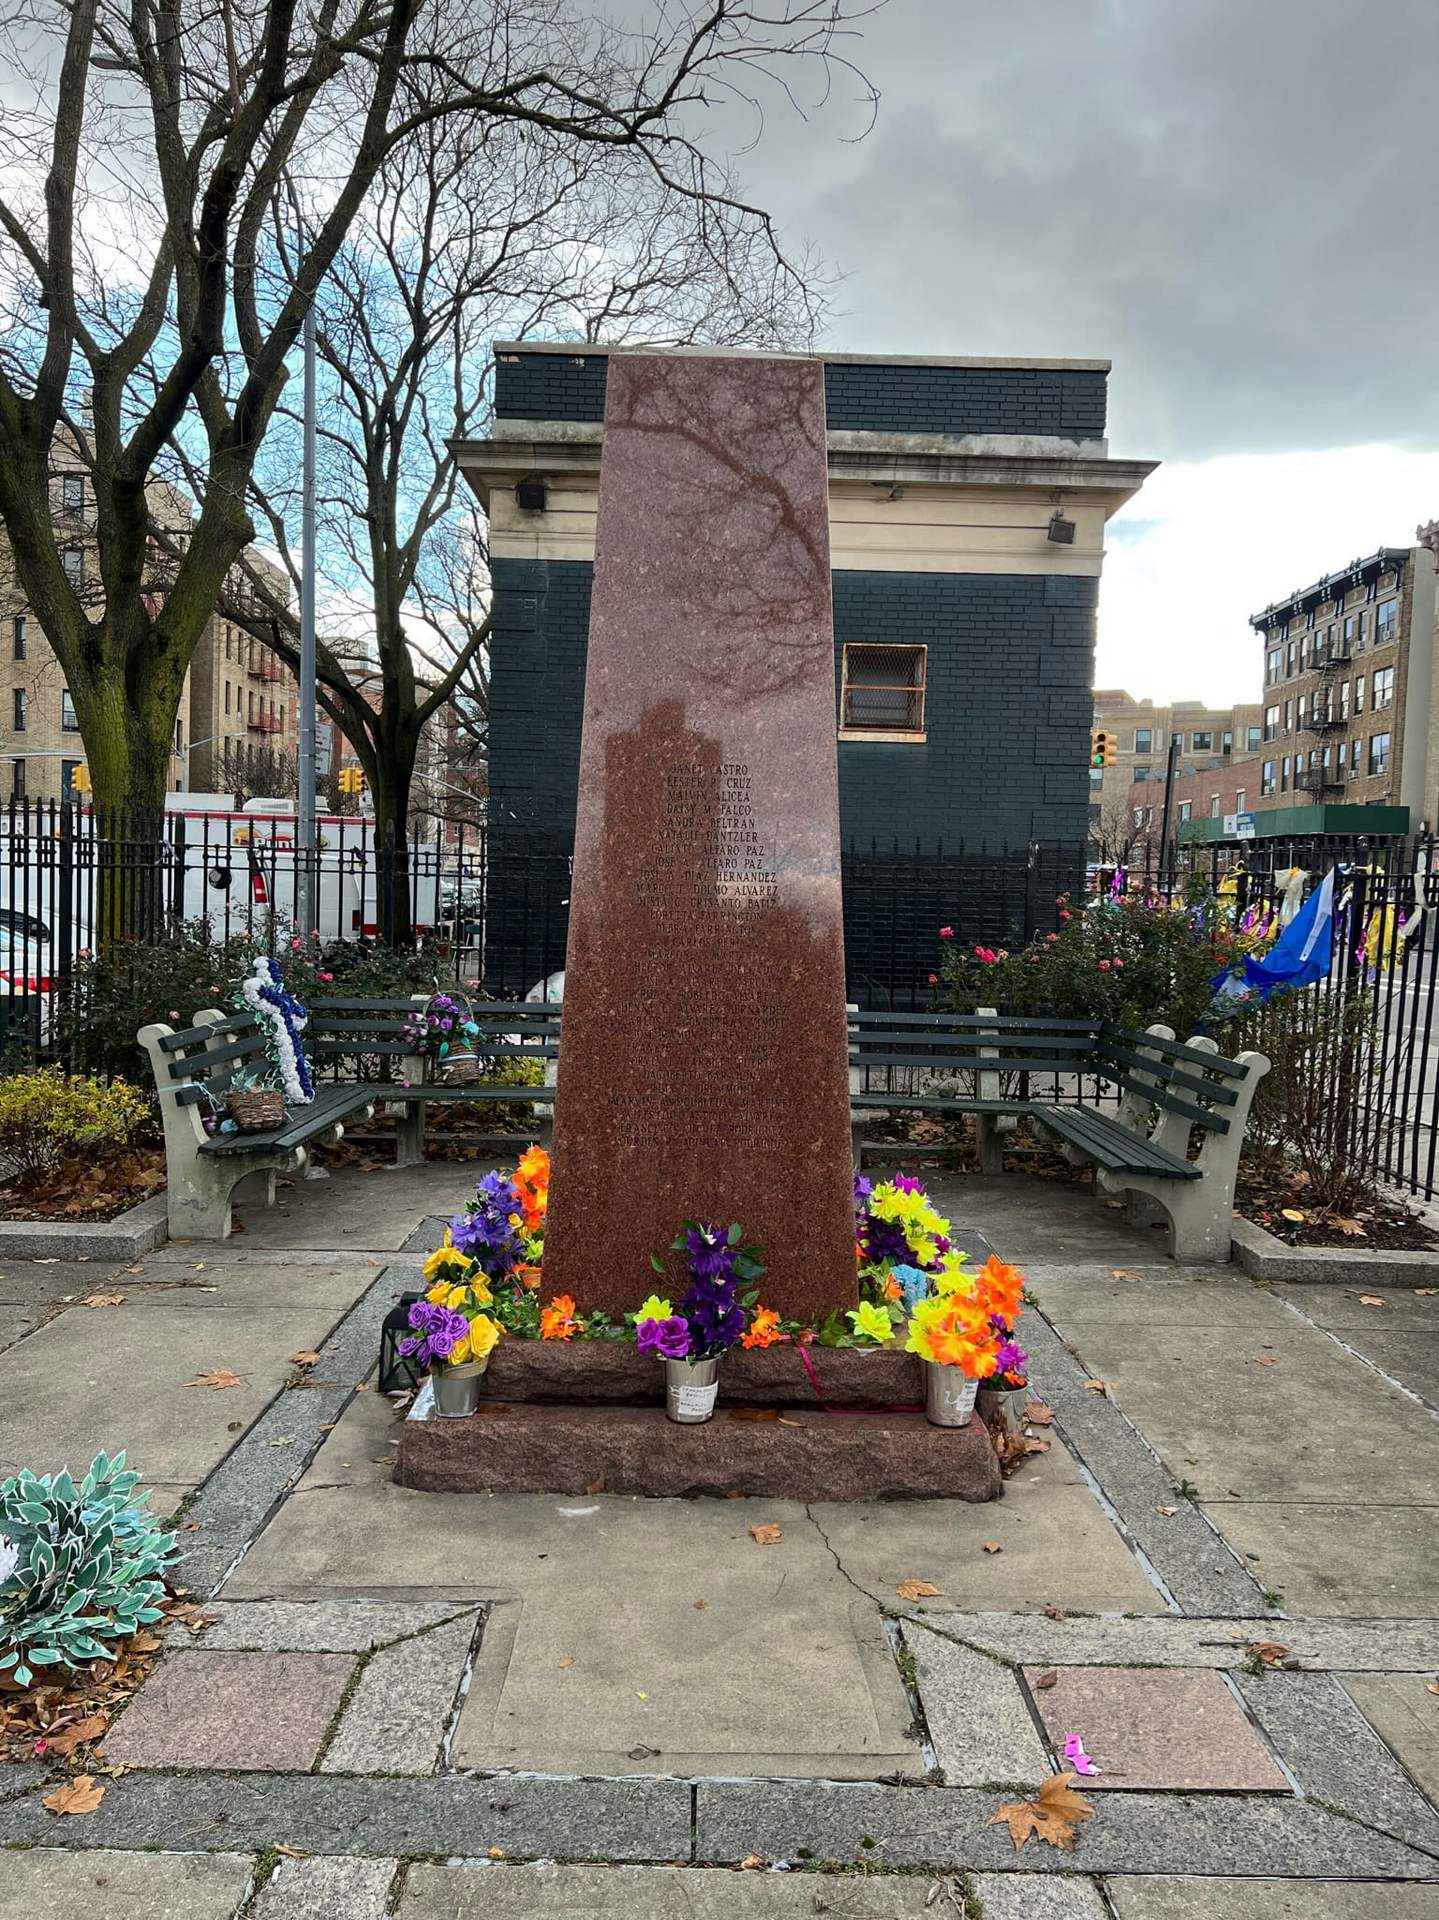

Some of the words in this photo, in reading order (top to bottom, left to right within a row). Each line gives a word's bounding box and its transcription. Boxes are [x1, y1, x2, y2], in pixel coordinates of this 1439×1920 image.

[711, 764, 749, 775] CASTRO
[726, 777, 752, 789] CRUZ
[714, 790, 750, 802] ALICEA
[720, 804, 752, 815] FALCO
[711, 818, 755, 829] BELTRAN
[706, 831, 758, 842] DANTZLER
[703, 845, 740, 856] ALFARO
[746, 845, 765, 857] PAZ
[700, 858, 738, 869] ALFARO
[744, 858, 763, 870] PAZ
[716, 871, 777, 883] HERNANDEZ
[735, 885, 778, 896] ALVAREZ
[690, 897, 741, 909] CRISANTO
